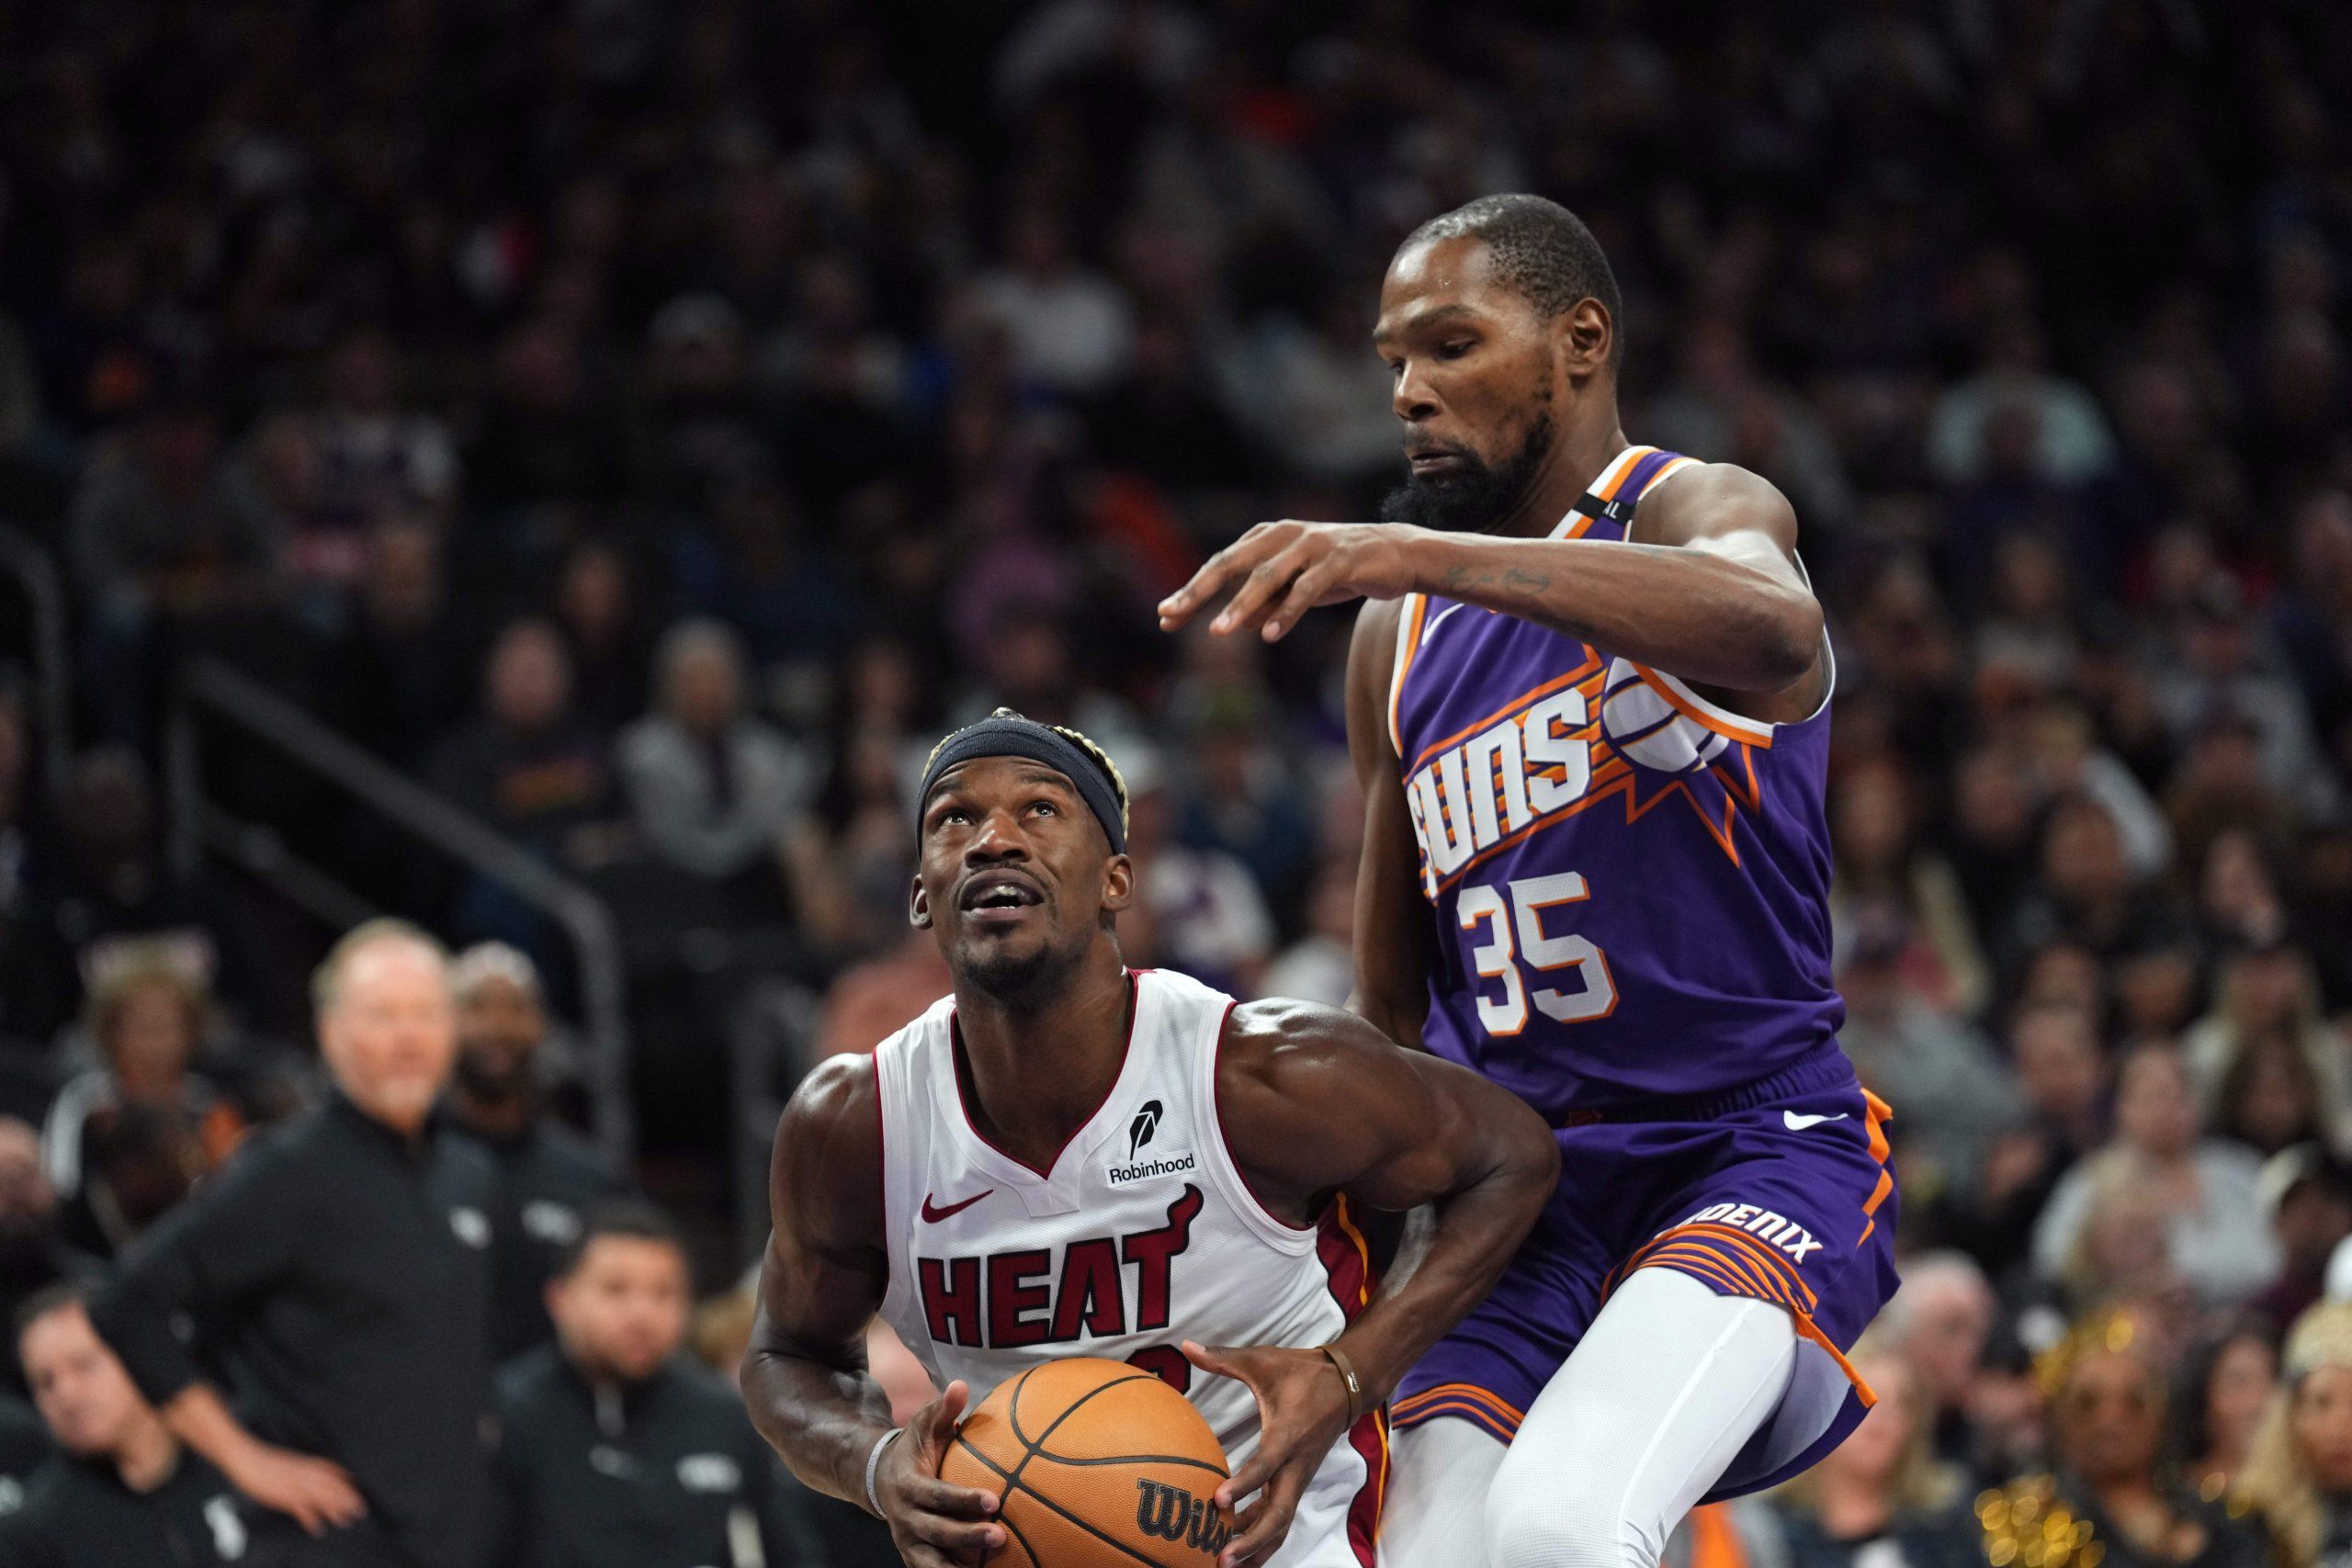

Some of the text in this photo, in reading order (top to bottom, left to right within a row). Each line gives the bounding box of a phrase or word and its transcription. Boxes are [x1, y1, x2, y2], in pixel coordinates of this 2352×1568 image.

[1456, 871, 1619, 1036] 35
[1109, 1153, 1195, 1184] Robinhood
[917, 1182, 1204, 1349] HEAT
[1654, 1202, 1824, 1265] OENIX
[1137, 1477, 1233, 1558] Wils
